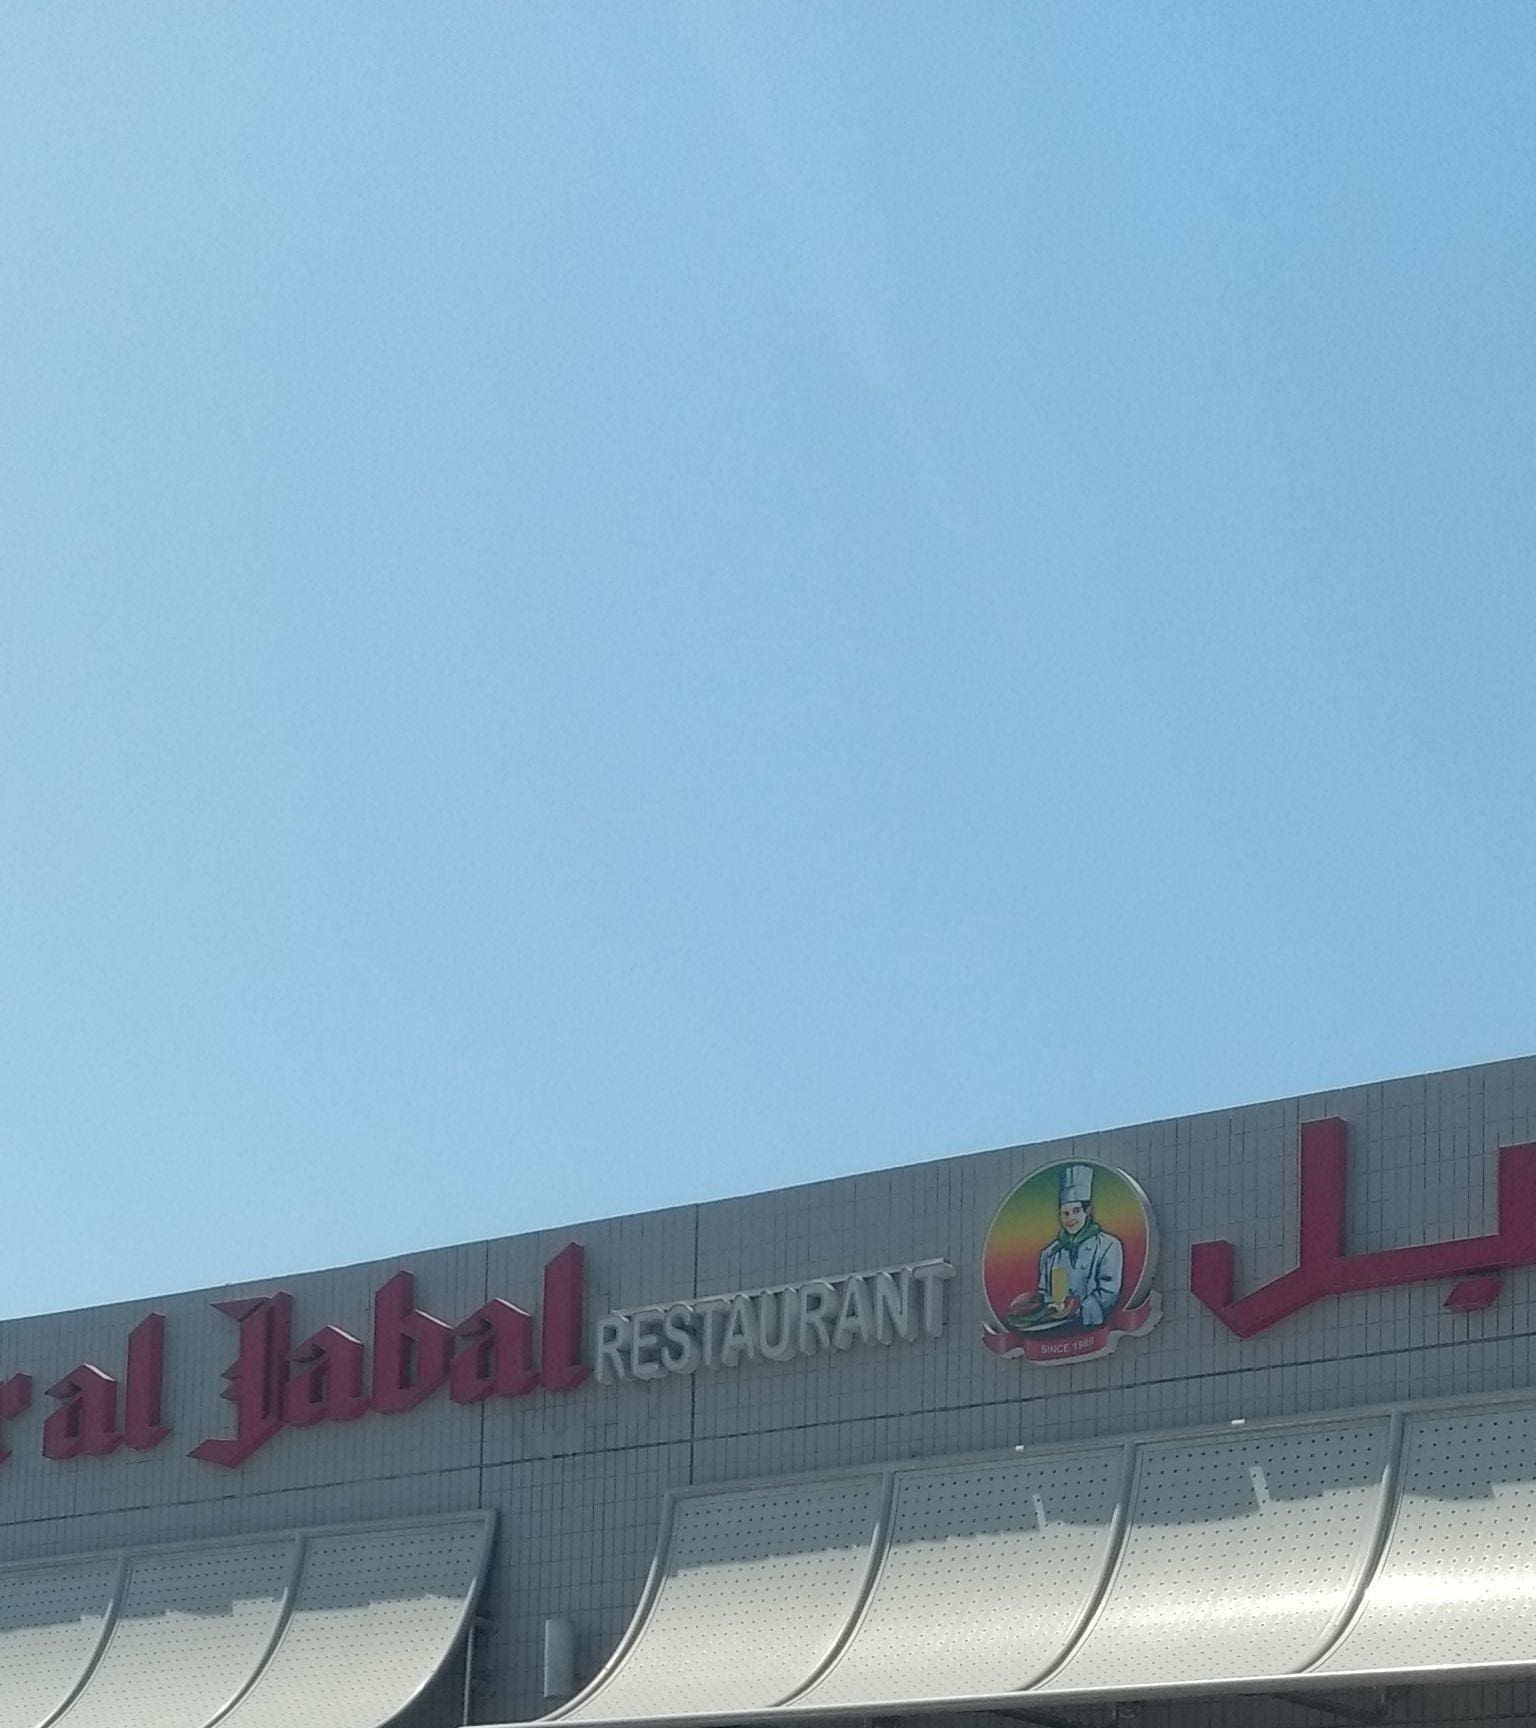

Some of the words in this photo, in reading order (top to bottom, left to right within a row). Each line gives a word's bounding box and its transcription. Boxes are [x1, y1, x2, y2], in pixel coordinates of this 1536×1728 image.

[43, 1312, 171, 1460] al
[186, 1241, 591, 1469] Jabal
[594, 1257, 956, 1386] RESTAURANT
[1041, 1342, 1069, 1354] SINCE
